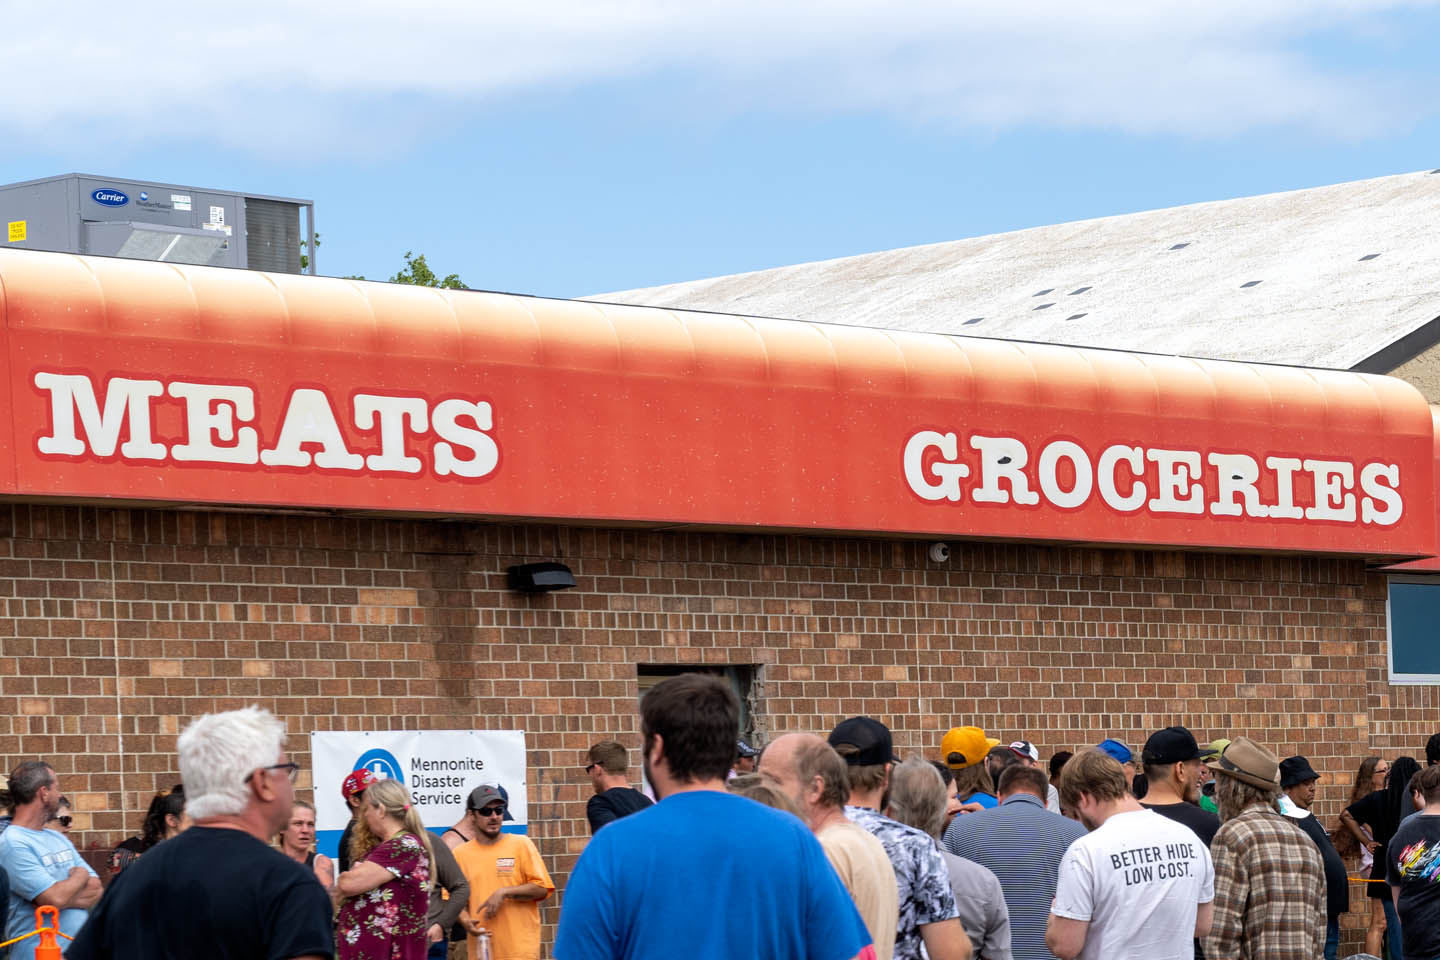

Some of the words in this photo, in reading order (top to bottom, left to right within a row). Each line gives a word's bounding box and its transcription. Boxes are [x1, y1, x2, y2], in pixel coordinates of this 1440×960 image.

[96, 191, 125, 202] Carrier
[34, 372, 499, 478] MEATS
[903, 430, 1403, 526] GROCERIES
[411, 757, 484, 771] Mennonite
[411, 774, 465, 788] Disaster
[411, 791, 462, 806] Service
[1110, 846, 1163, 870] BETTER
[1125, 868, 1153, 886] LOW
[1158, 861, 1193, 880] COST.
